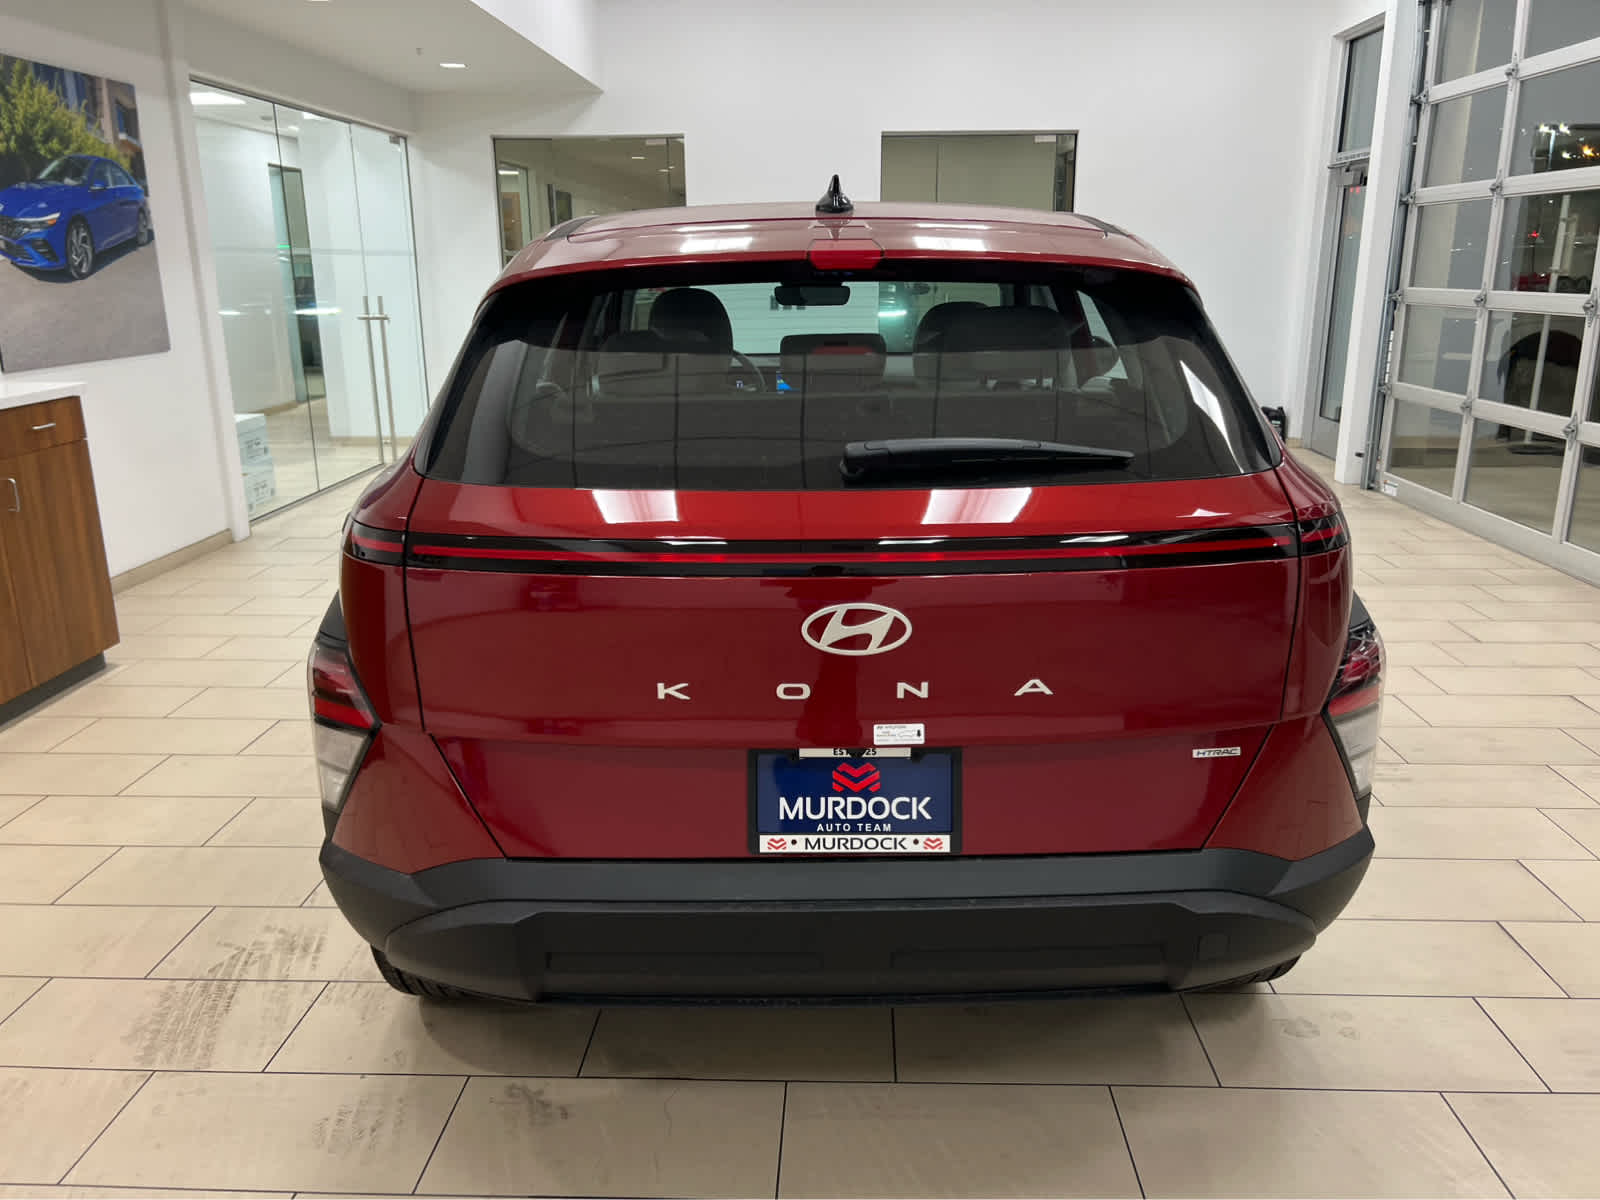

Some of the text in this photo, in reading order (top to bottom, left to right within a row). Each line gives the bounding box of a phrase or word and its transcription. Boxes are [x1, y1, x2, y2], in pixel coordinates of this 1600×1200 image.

[657, 679, 1053, 700] KONA
[1197, 748, 1240, 756] HTRAC
[779, 796, 932, 820] MURDOCK
[816, 823, 892, 832] AUTO TEAM
[804, 837, 907, 850] MURDOCK
